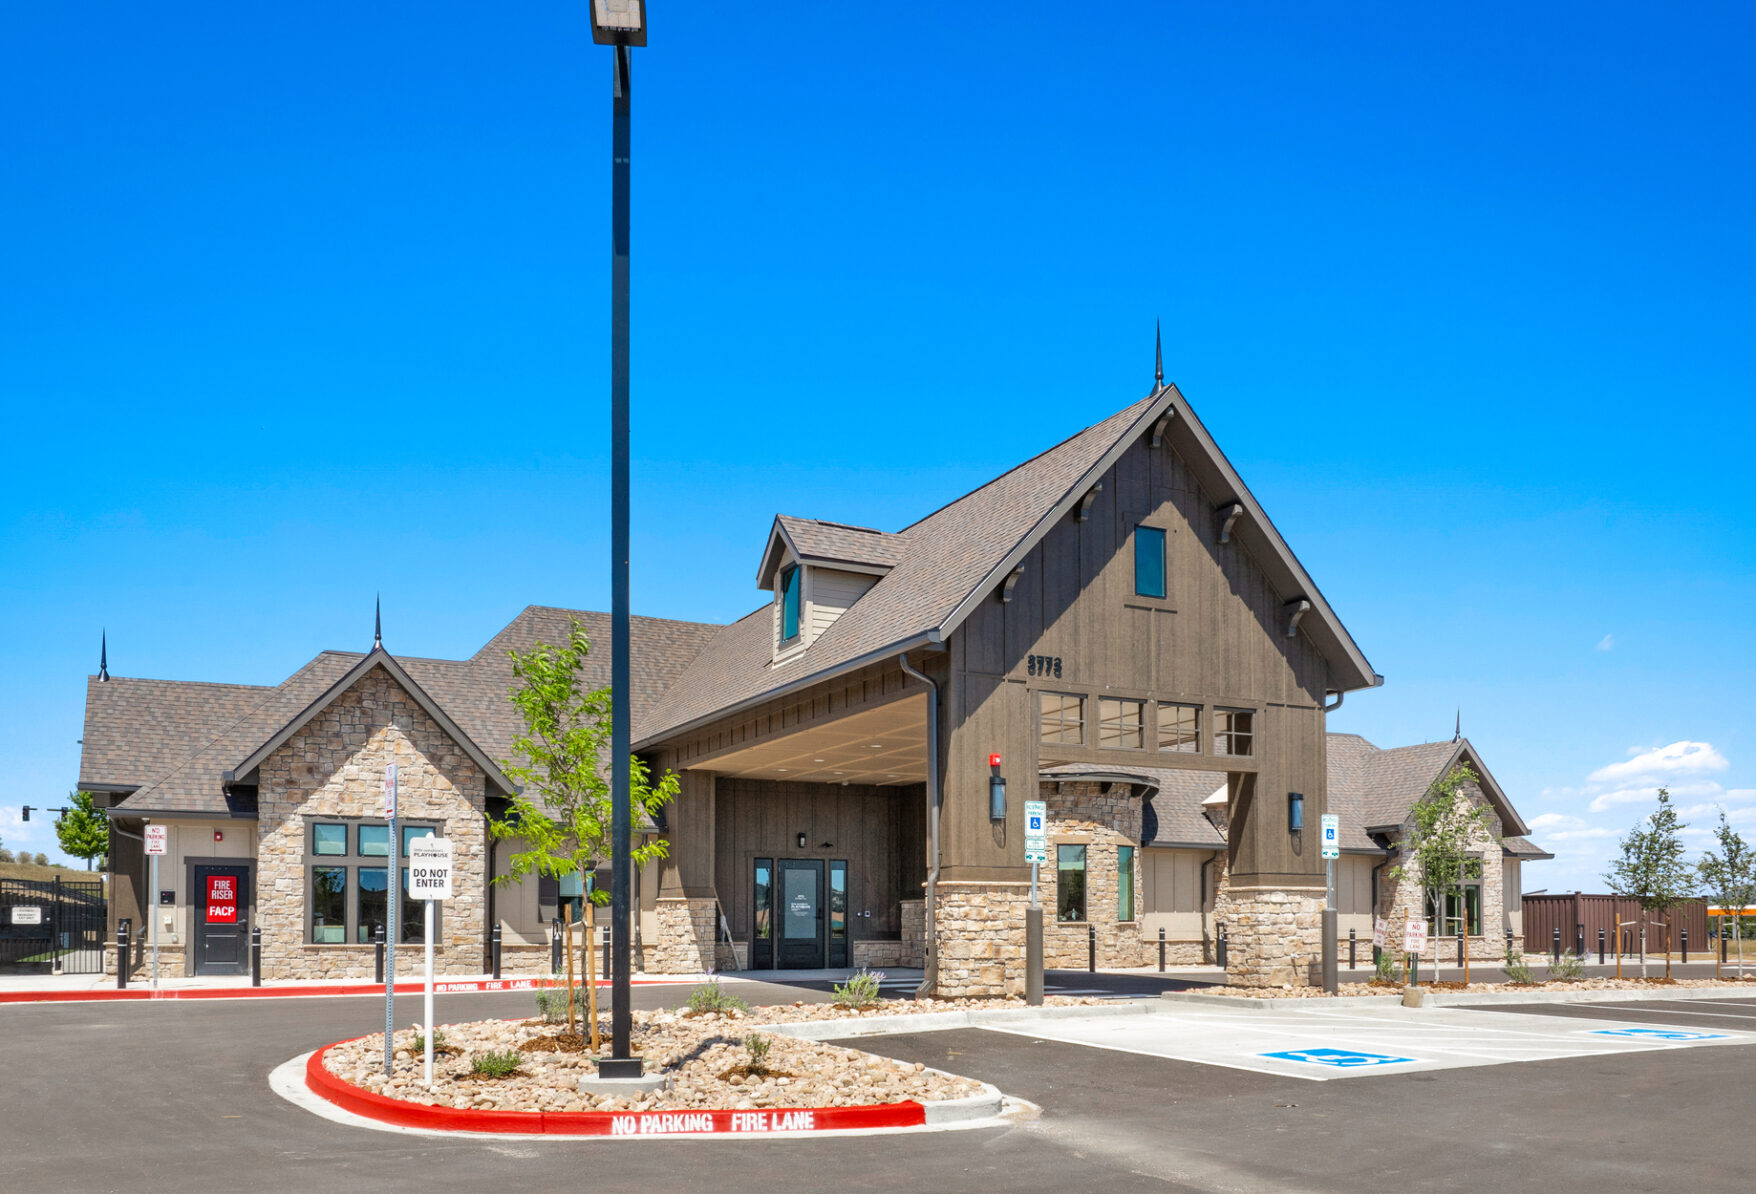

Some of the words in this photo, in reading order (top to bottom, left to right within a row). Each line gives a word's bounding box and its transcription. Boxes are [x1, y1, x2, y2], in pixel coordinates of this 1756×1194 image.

[413, 868, 427, 878] DO
[430, 868, 449, 878] NOT
[214, 880, 231, 890] FIRE
[416, 878, 445, 888] ENTER
[211, 889, 233, 900] RISER
[209, 906, 235, 916] FACP
[436, 984, 447, 992] NO
[448, 983, 478, 991] PARKING
[486, 981, 503, 989] FIRE
[510, 980, 533, 988] LANE
[611, 1115, 636, 1134] NO
[640, 1113, 713, 1134] PARKING
[731, 1112, 768, 1132] FIRE
[771, 1111, 814, 1130] LANE
